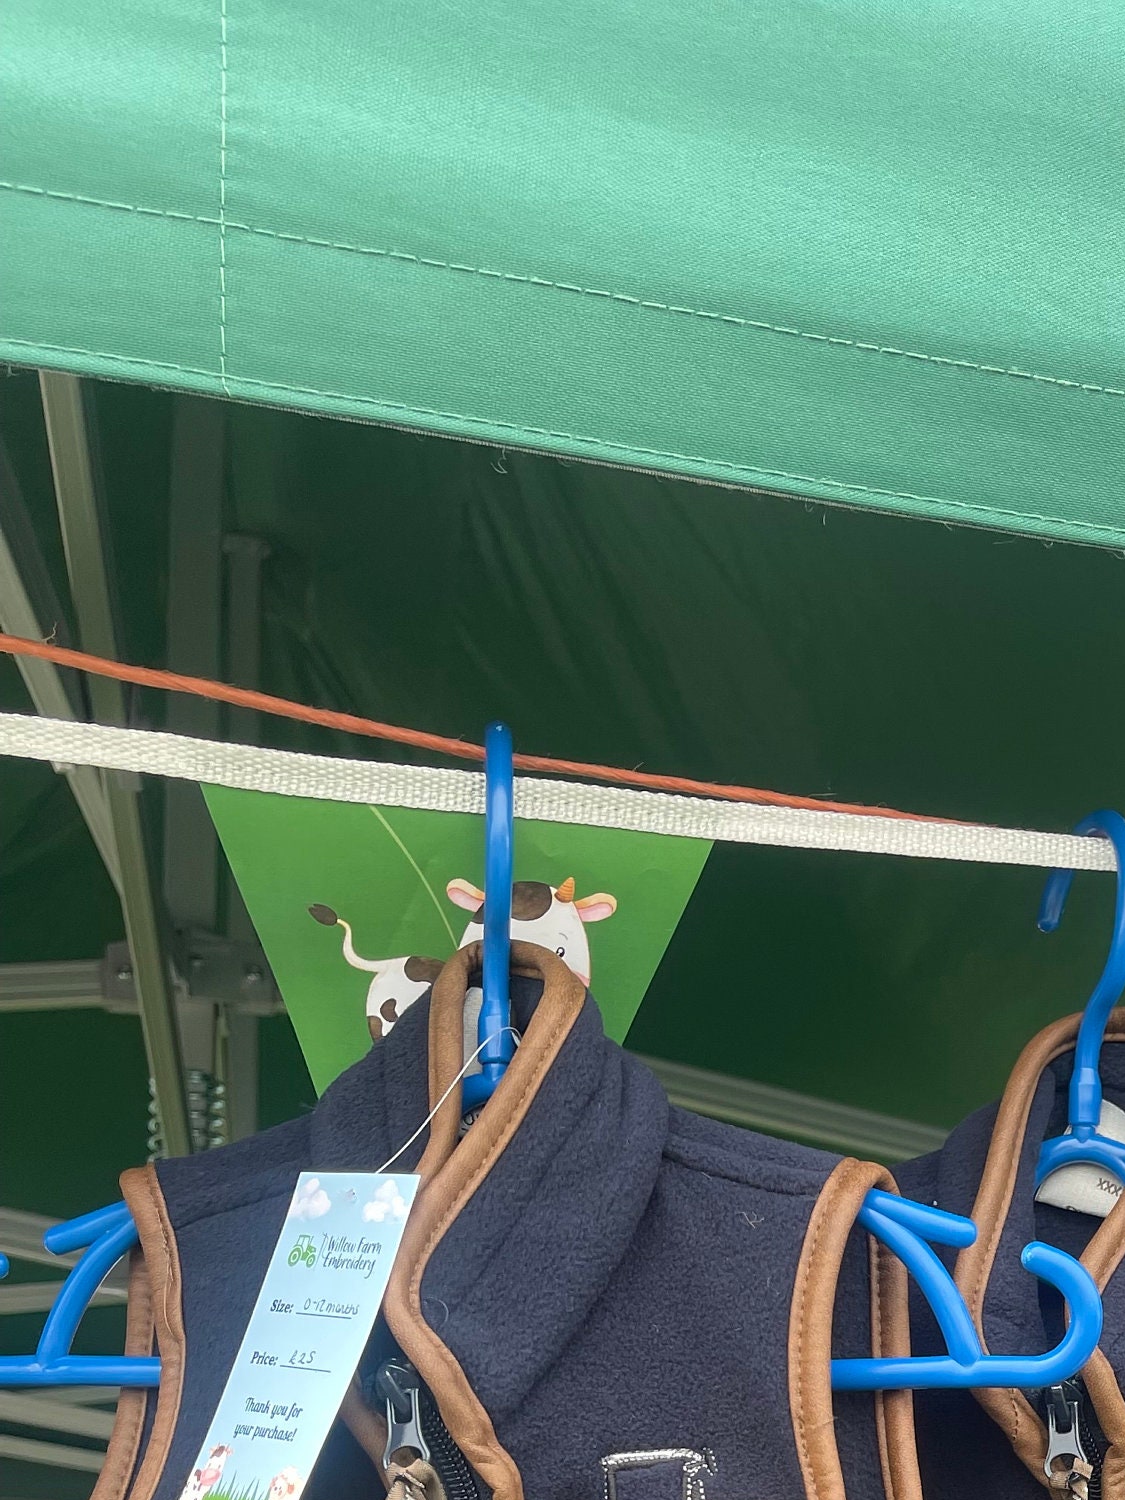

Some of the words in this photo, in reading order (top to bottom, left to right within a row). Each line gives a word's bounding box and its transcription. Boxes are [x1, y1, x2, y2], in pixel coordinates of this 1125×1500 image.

[327, 1235, 357, 1253] Willow
[357, 1236, 382, 1254] Farm
[323, 1252, 376, 1279] Embroidery
[270, 1299, 294, 1314] Size:
[250, 1350, 279, 1366] Price:
[288, 1349, 316, 1365] £25
[244, 1397, 271, 1415] Thank
[270, 1403, 289, 1419] you
[285, 1402, 303, 1421] for
[233, 1424, 255, 1438] your
[252, 1425, 298, 1442] purchase!
